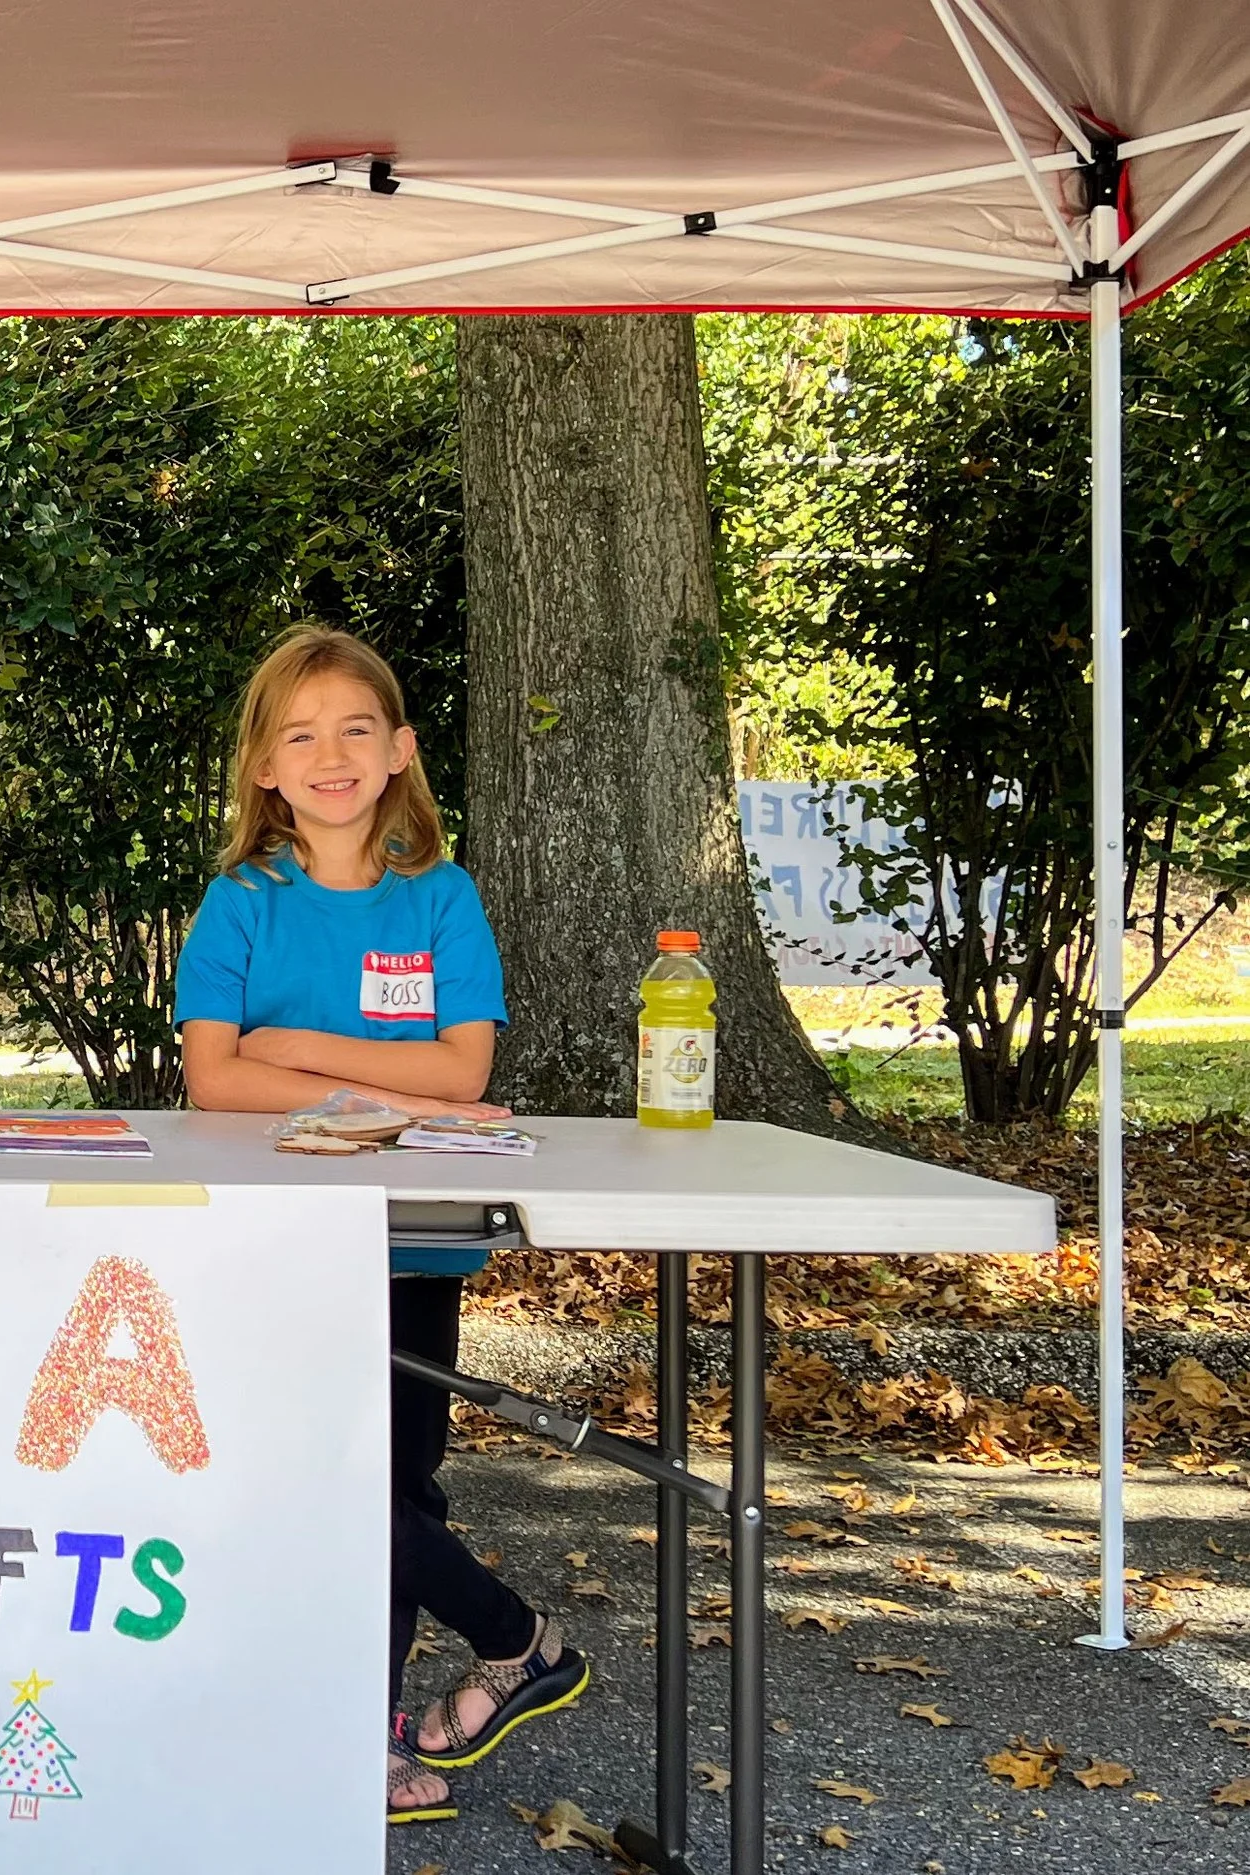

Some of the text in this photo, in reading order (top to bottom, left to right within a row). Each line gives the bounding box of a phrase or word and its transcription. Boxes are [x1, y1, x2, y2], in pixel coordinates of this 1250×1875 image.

[380, 954, 424, 969] HELLO
[381, 980, 423, 1006] BOSS
[662, 1057, 707, 1073] ZERO
[14, 1255, 210, 1474] A
